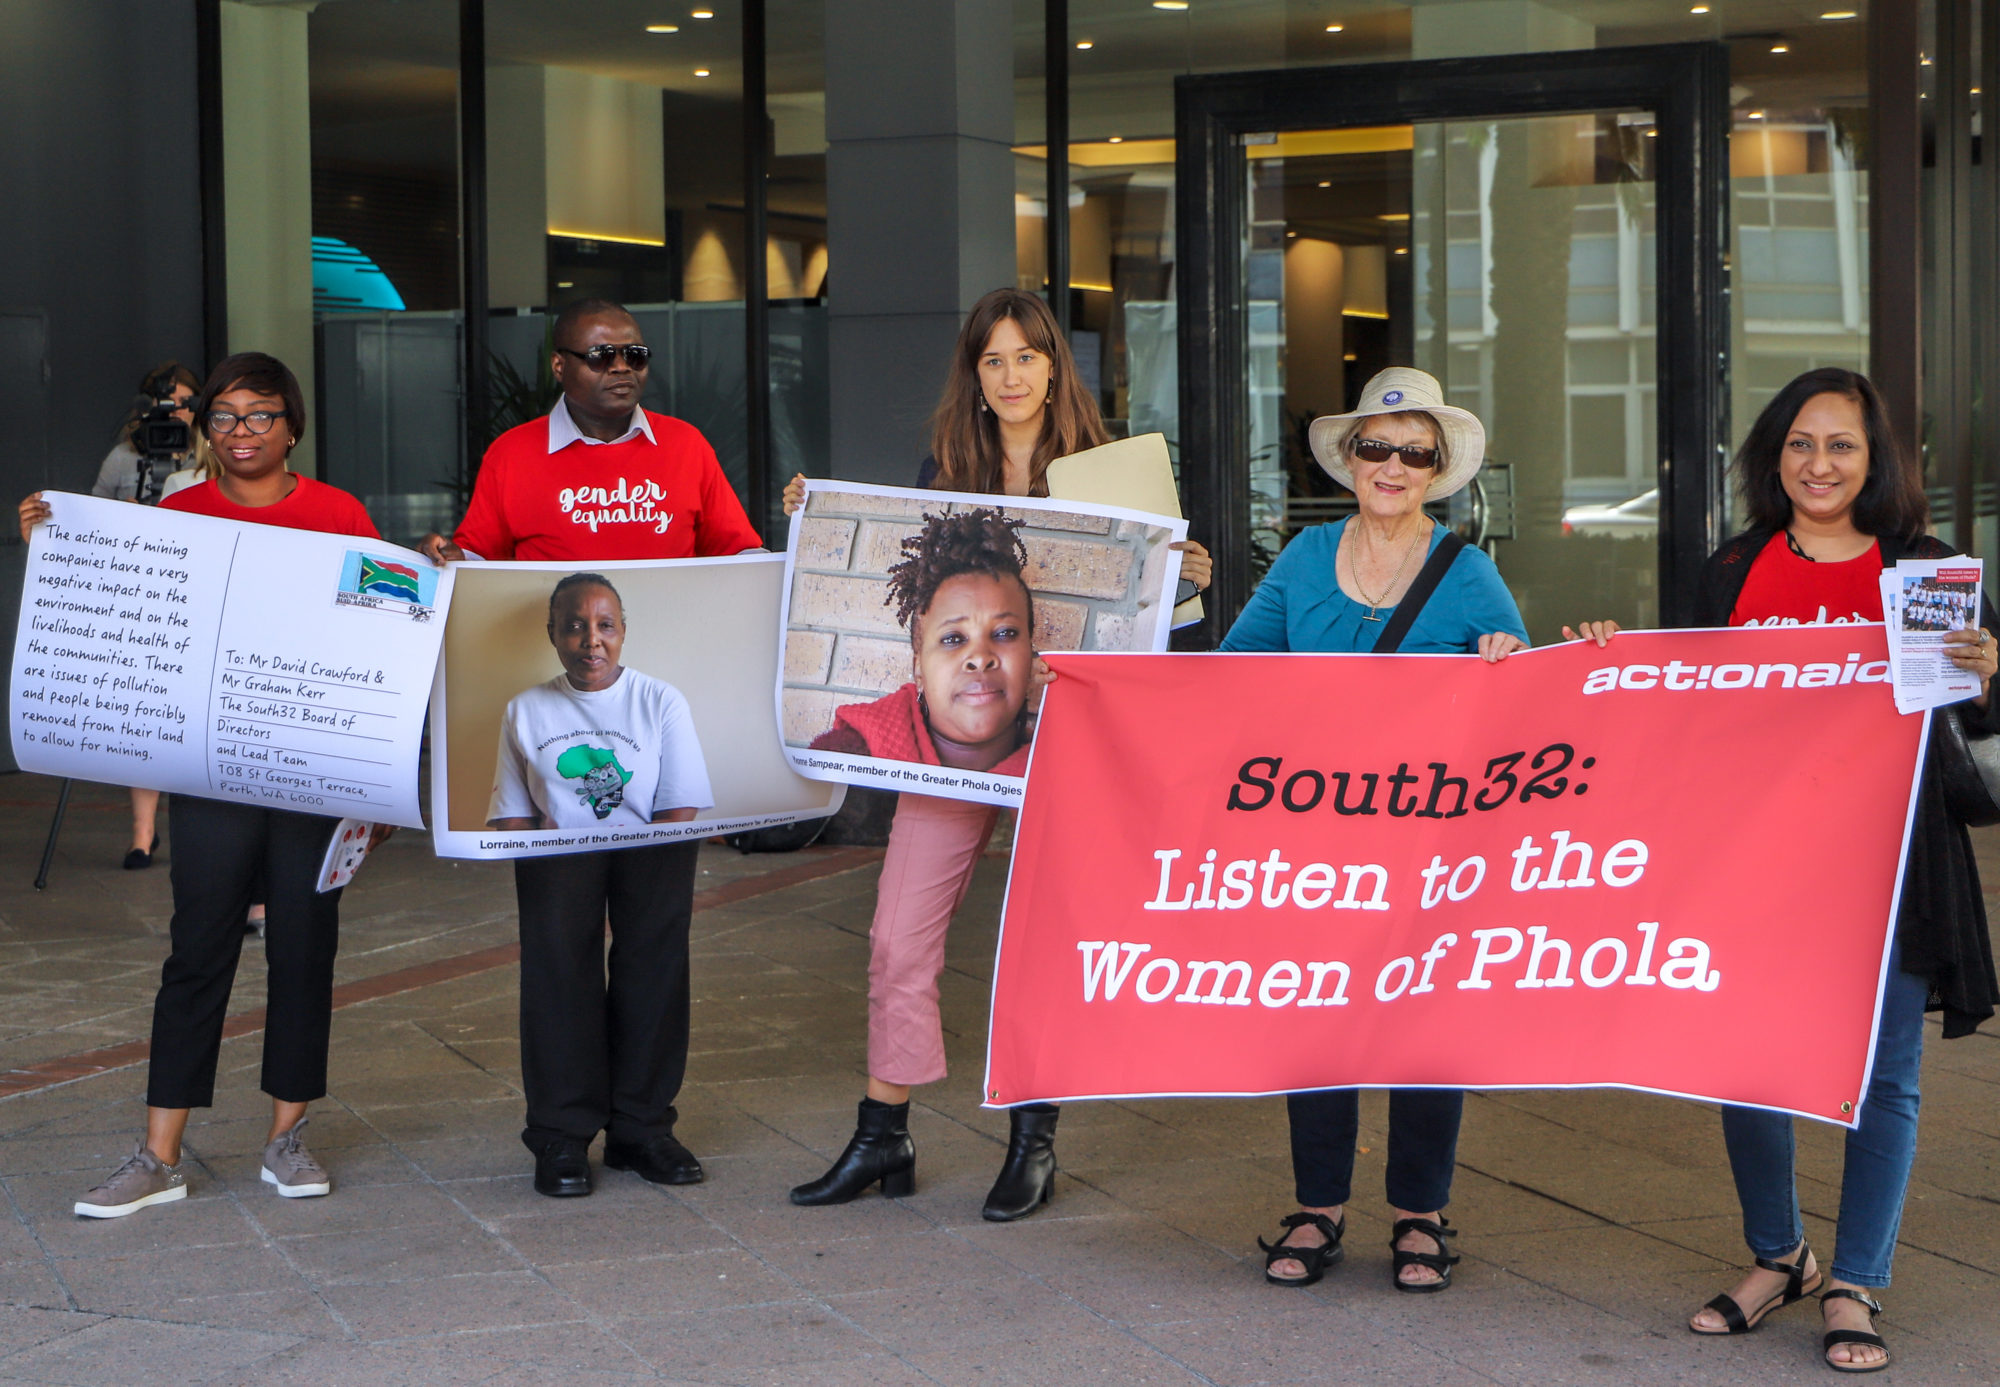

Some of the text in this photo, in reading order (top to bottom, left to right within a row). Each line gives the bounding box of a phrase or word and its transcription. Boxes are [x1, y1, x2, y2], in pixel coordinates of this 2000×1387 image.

[559, 477, 667, 513] gender
[572, 499, 674, 534] equality
[47, 524, 189, 559] The actions of mining
[42, 551, 189, 583] companies have a very
[38, 574, 188, 604] negative impact on the
[35, 595, 189, 628] environment and on the
[32, 615, 190, 655] livelihoods and health of
[28, 639, 183, 674] the communities. There
[225, 650, 385, 685] To: Mr David Crawford &
[24, 664, 168, 695] are issues of pollution
[222, 673, 326, 701] Mr Graham Kerr
[22, 686, 186, 724] and people being forcibly
[220, 696, 357, 731] The South32 Board of
[22, 710, 184, 744] removed from their land
[217, 719, 271, 740] Directors
[537, 733, 569, 751] Nothing
[570, 730, 594, 738] about
[605, 730, 634, 745] without
[633, 743, 641, 752] us
[23, 730, 153, 761] to allow for mining.
[217, 744, 308, 768] and Lead Team
[218, 764, 368, 798] 108 St Georges Terrace,
[809, 757, 844, 772] Sampear,
[847, 763, 888, 777] member
[890, 769, 902, 779] of
[903, 770, 919, 781] the
[921, 773, 960, 787] Greater
[961, 778, 990, 791] Phola
[992, 783, 1023, 796] Ogies
[1226, 742, 1596, 819] South32:
[220, 783, 324, 807] Perth, WA 6000
[480, 815, 795, 850] Lorraine, member of the Greater Phola Ogies Women's Forum
[1143, 830, 1649, 911] Listen to the
[1076, 921, 1721, 1008] Women of Phola
